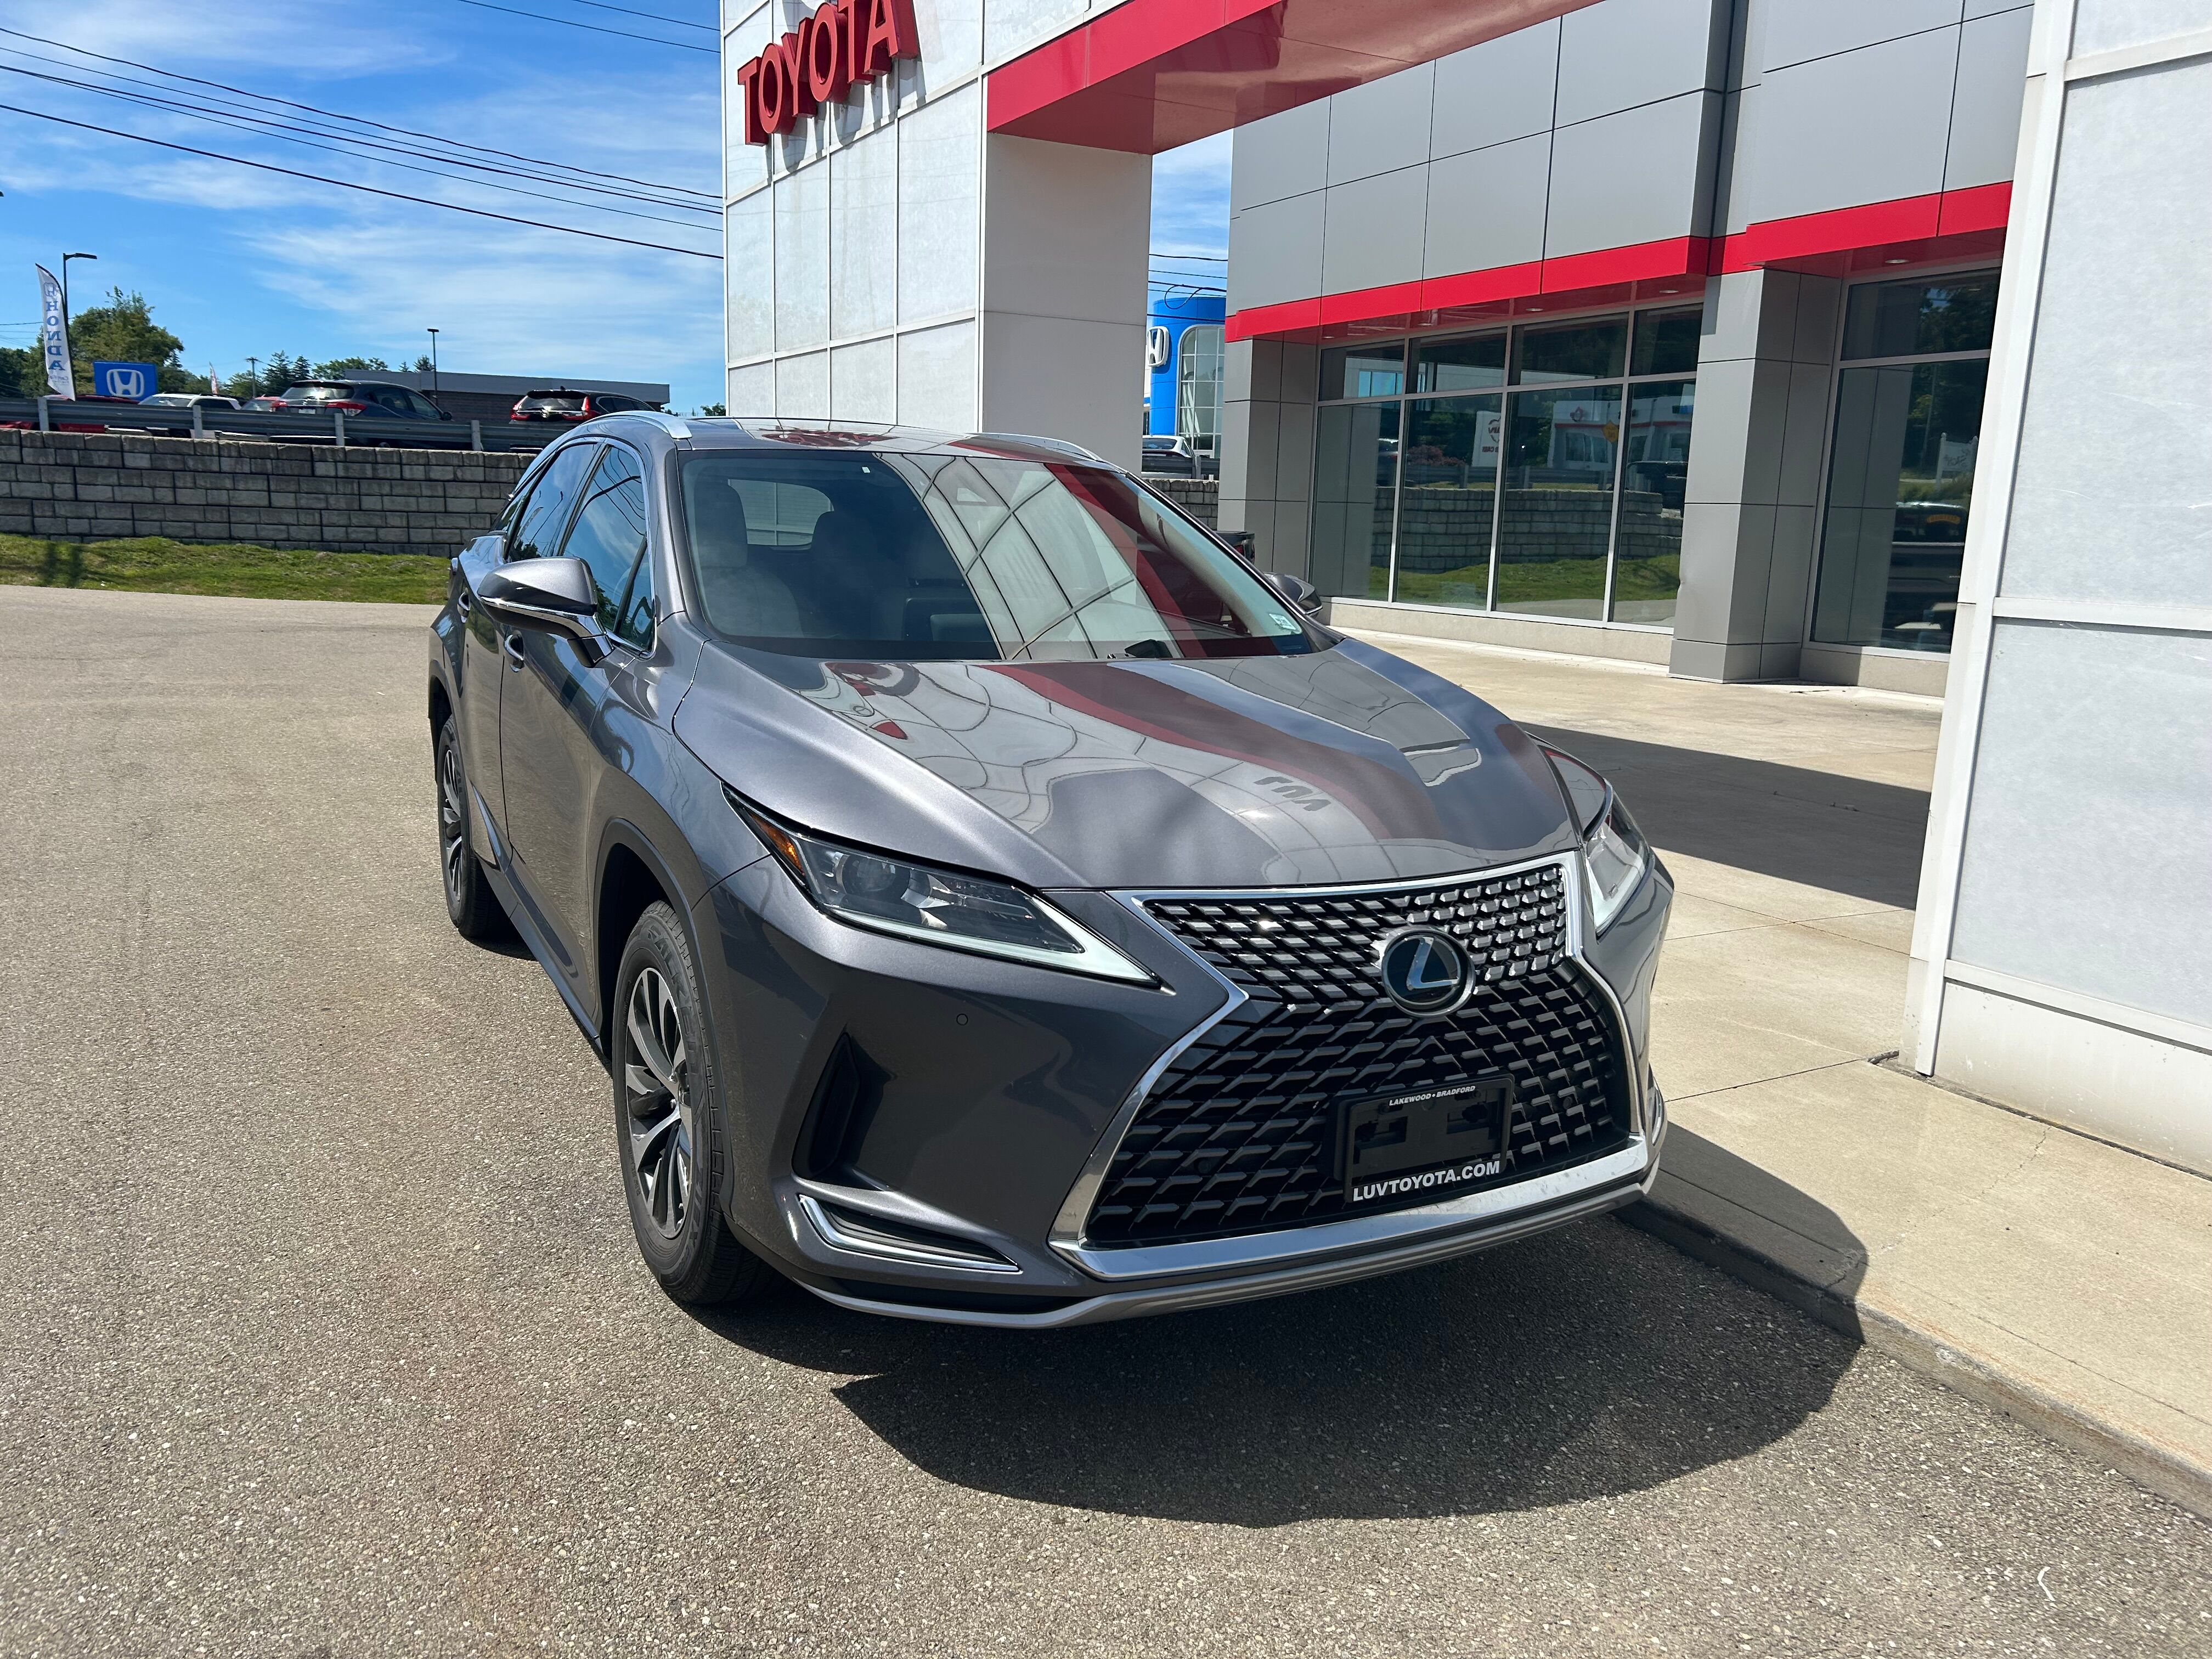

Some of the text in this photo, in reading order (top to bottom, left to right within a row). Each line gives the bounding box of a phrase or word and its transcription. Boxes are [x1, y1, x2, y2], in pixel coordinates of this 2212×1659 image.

[737, 0, 918, 146] TOYOTA
[1389, 1085, 1476, 1106] LAKEWOOD BRADFORD
[1353, 1160, 1500, 1201] LUVTOYOTA.COM
